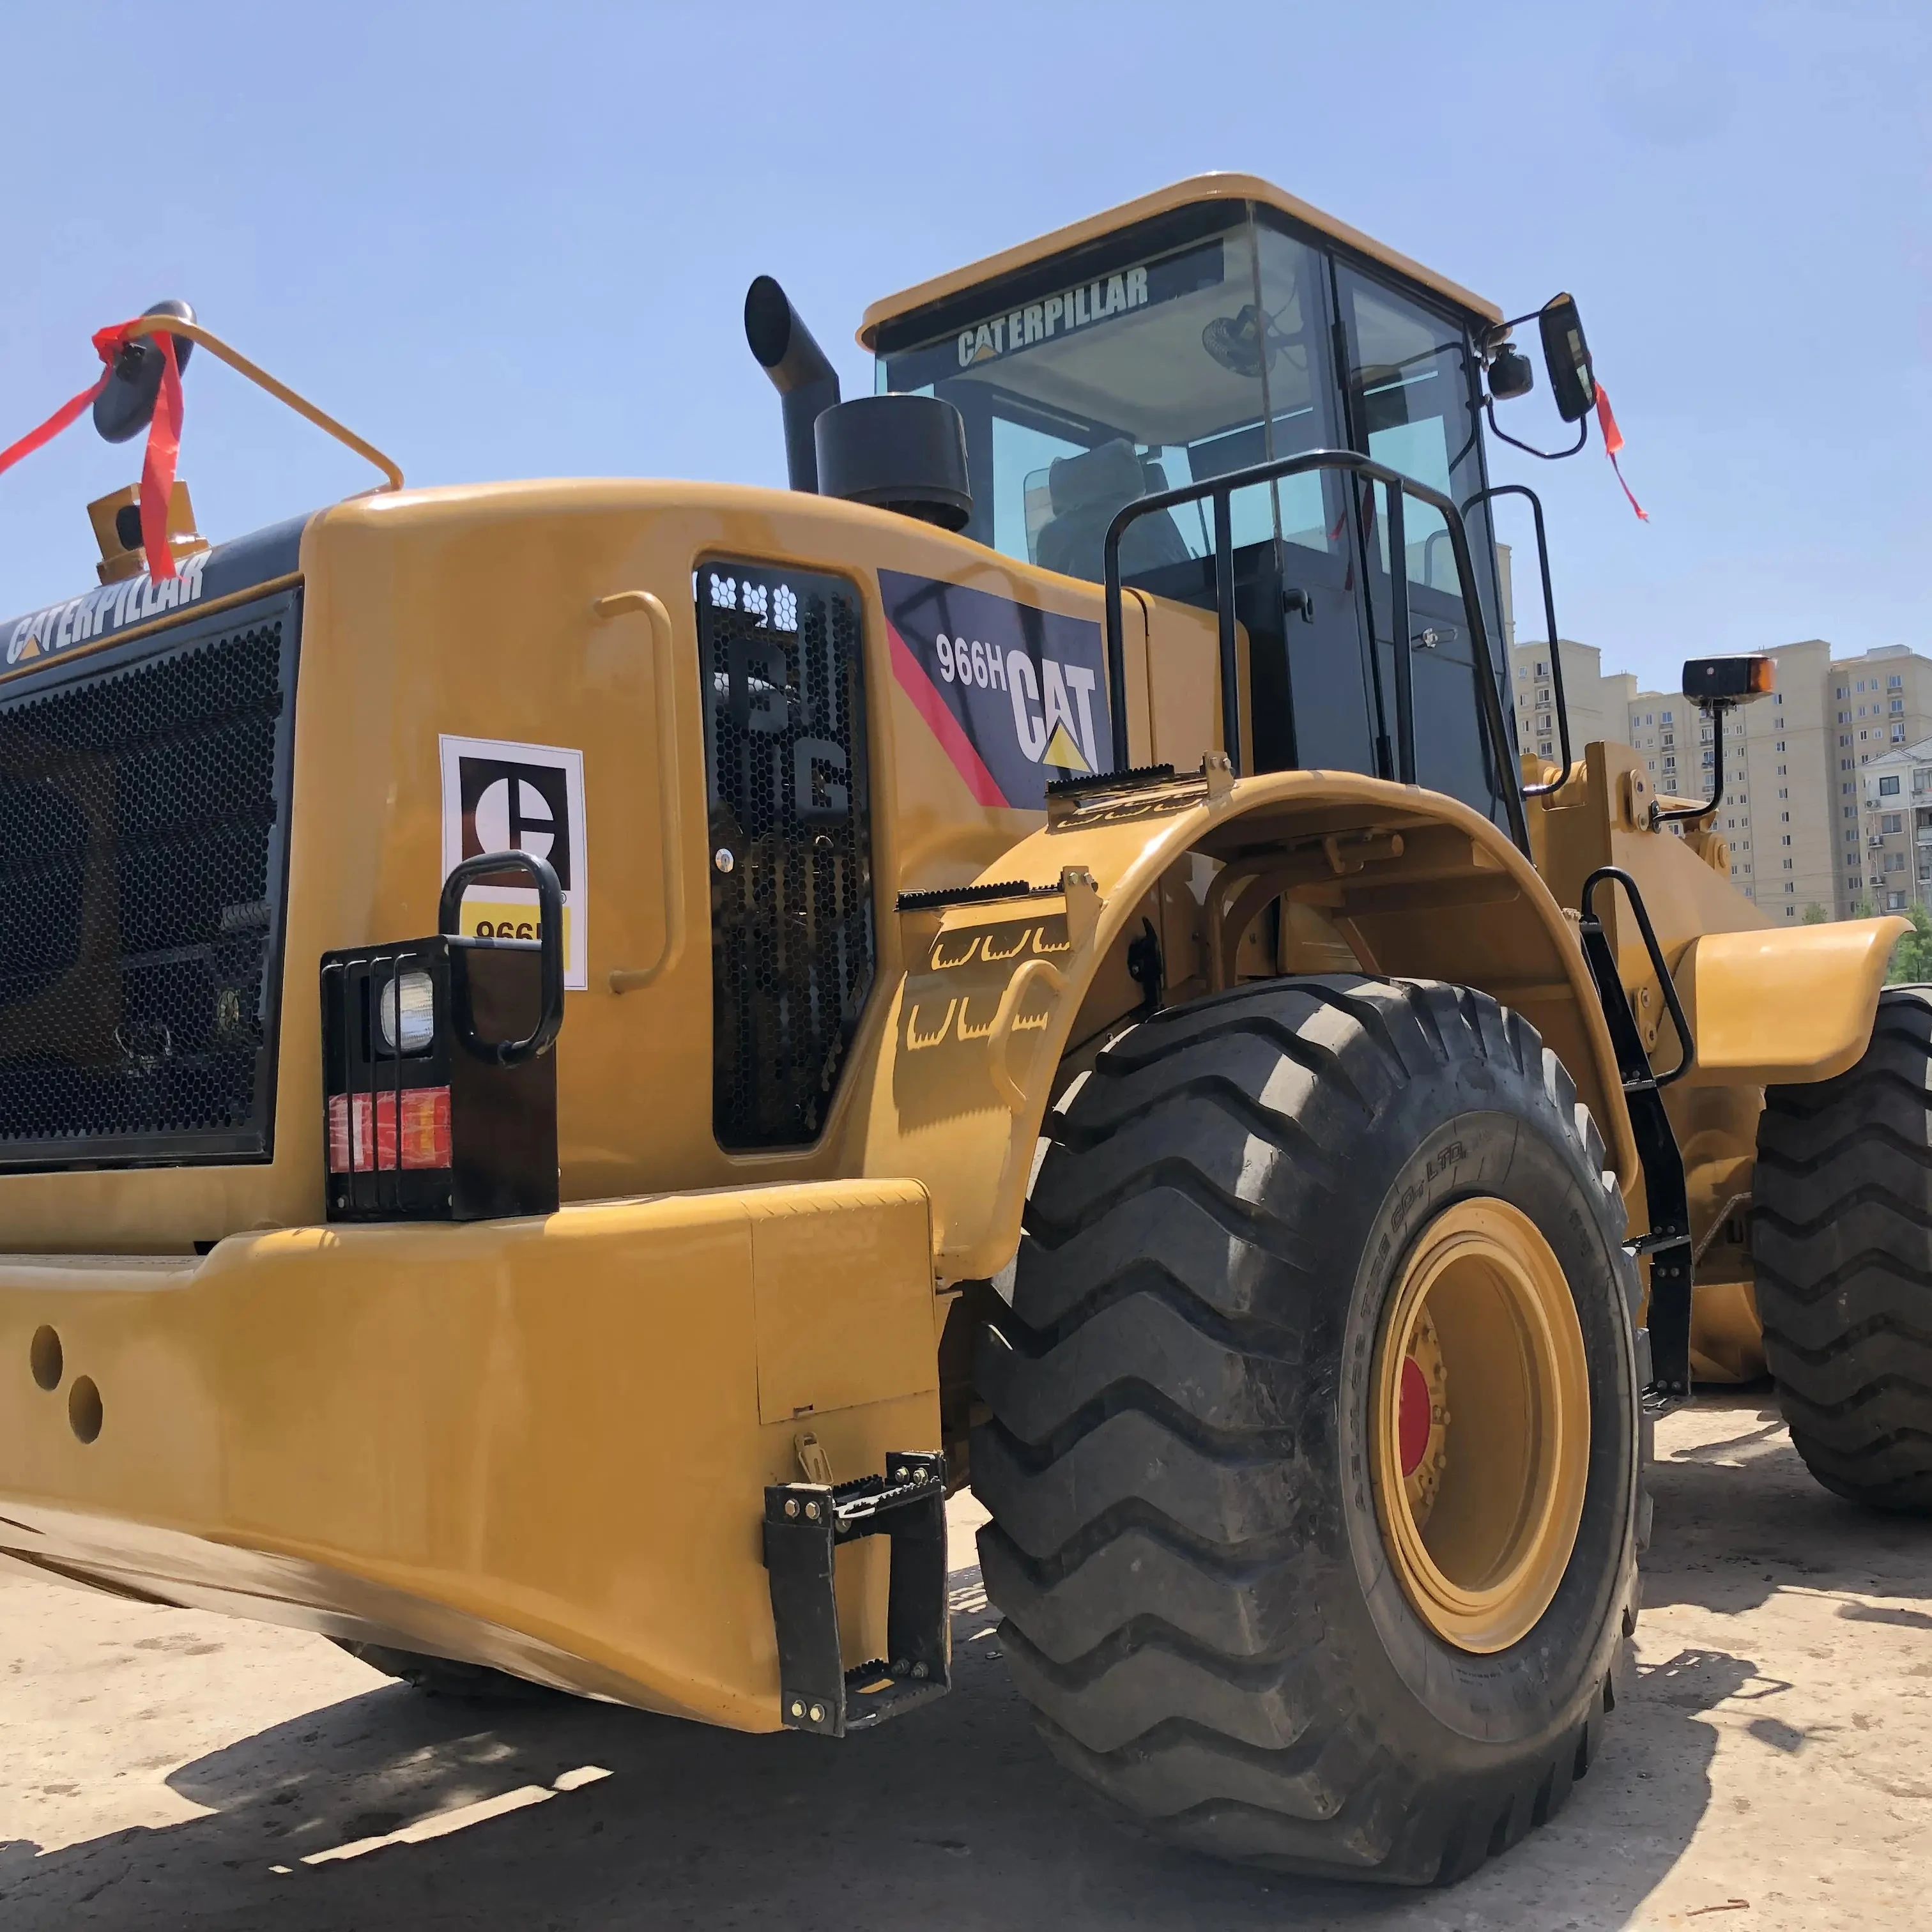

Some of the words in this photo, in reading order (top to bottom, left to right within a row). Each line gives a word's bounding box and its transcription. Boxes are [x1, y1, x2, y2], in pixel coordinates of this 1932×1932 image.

[958, 267, 1148, 367] CATERPILLAR
[6, 550, 212, 664] CATERPILLAR
[936, 634, 1008, 692] 966H
[1006, 650, 1099, 774] CAT
